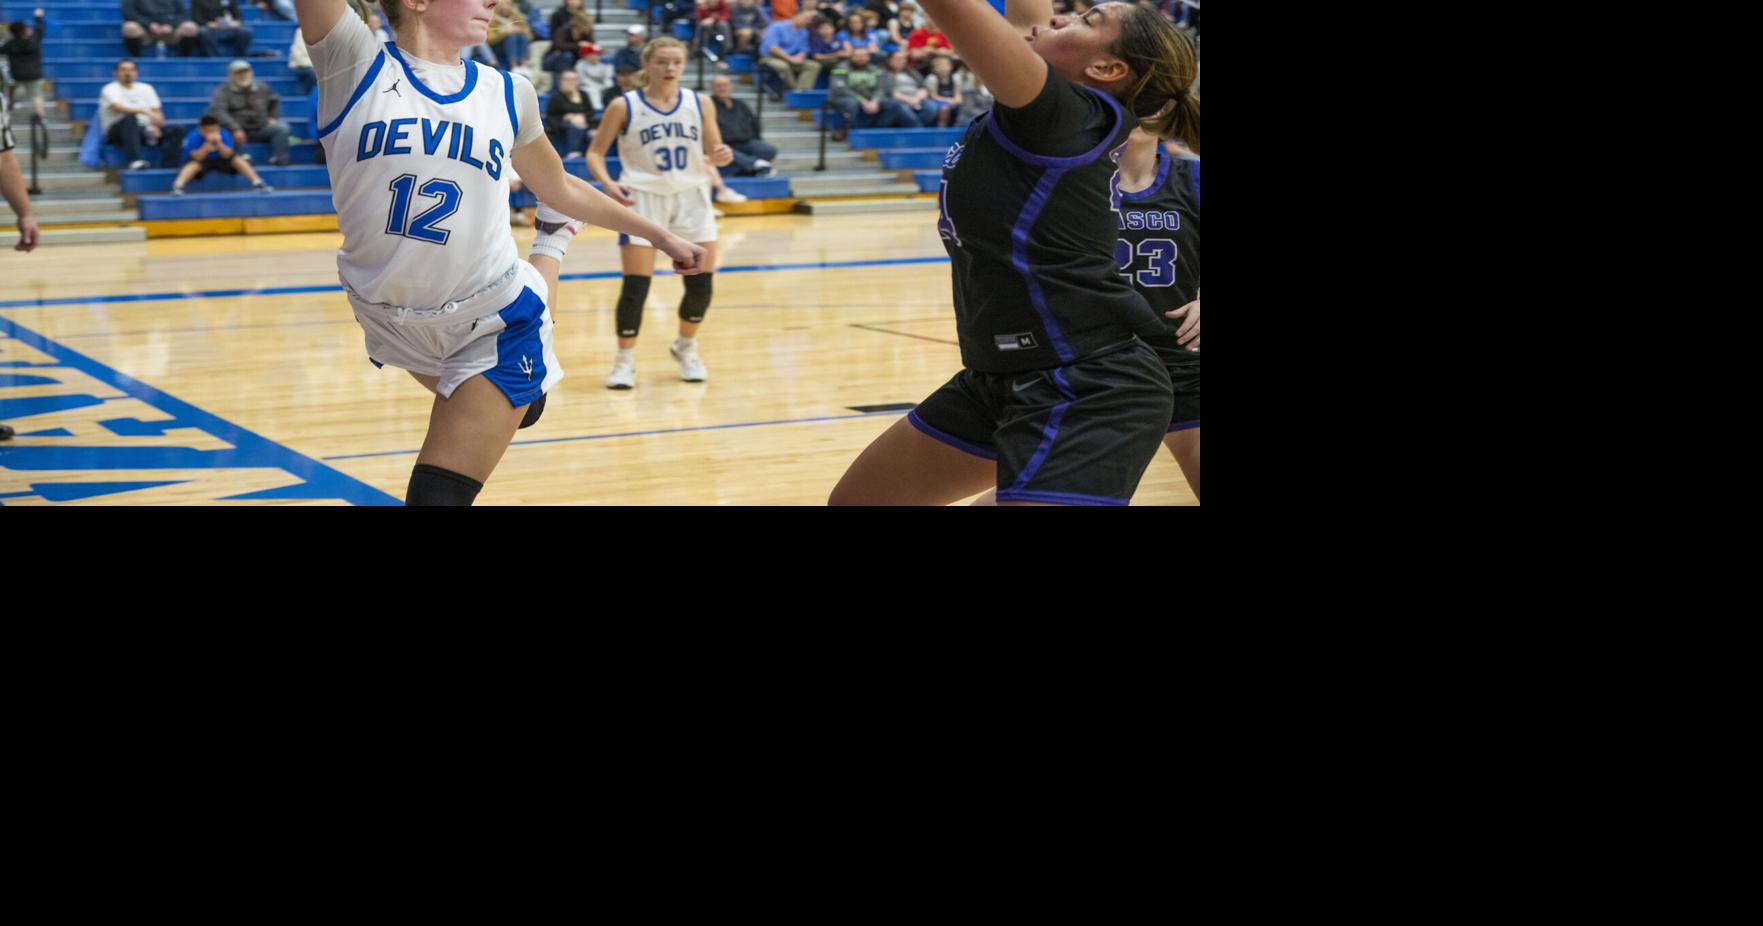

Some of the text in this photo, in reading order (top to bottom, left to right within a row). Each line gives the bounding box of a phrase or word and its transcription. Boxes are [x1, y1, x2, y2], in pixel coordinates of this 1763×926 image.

[356, 117, 505, 182] DEVILS
[640, 122, 699, 146] DEVILS
[655, 145, 688, 172] 30
[385, 173, 464, 245] 12
